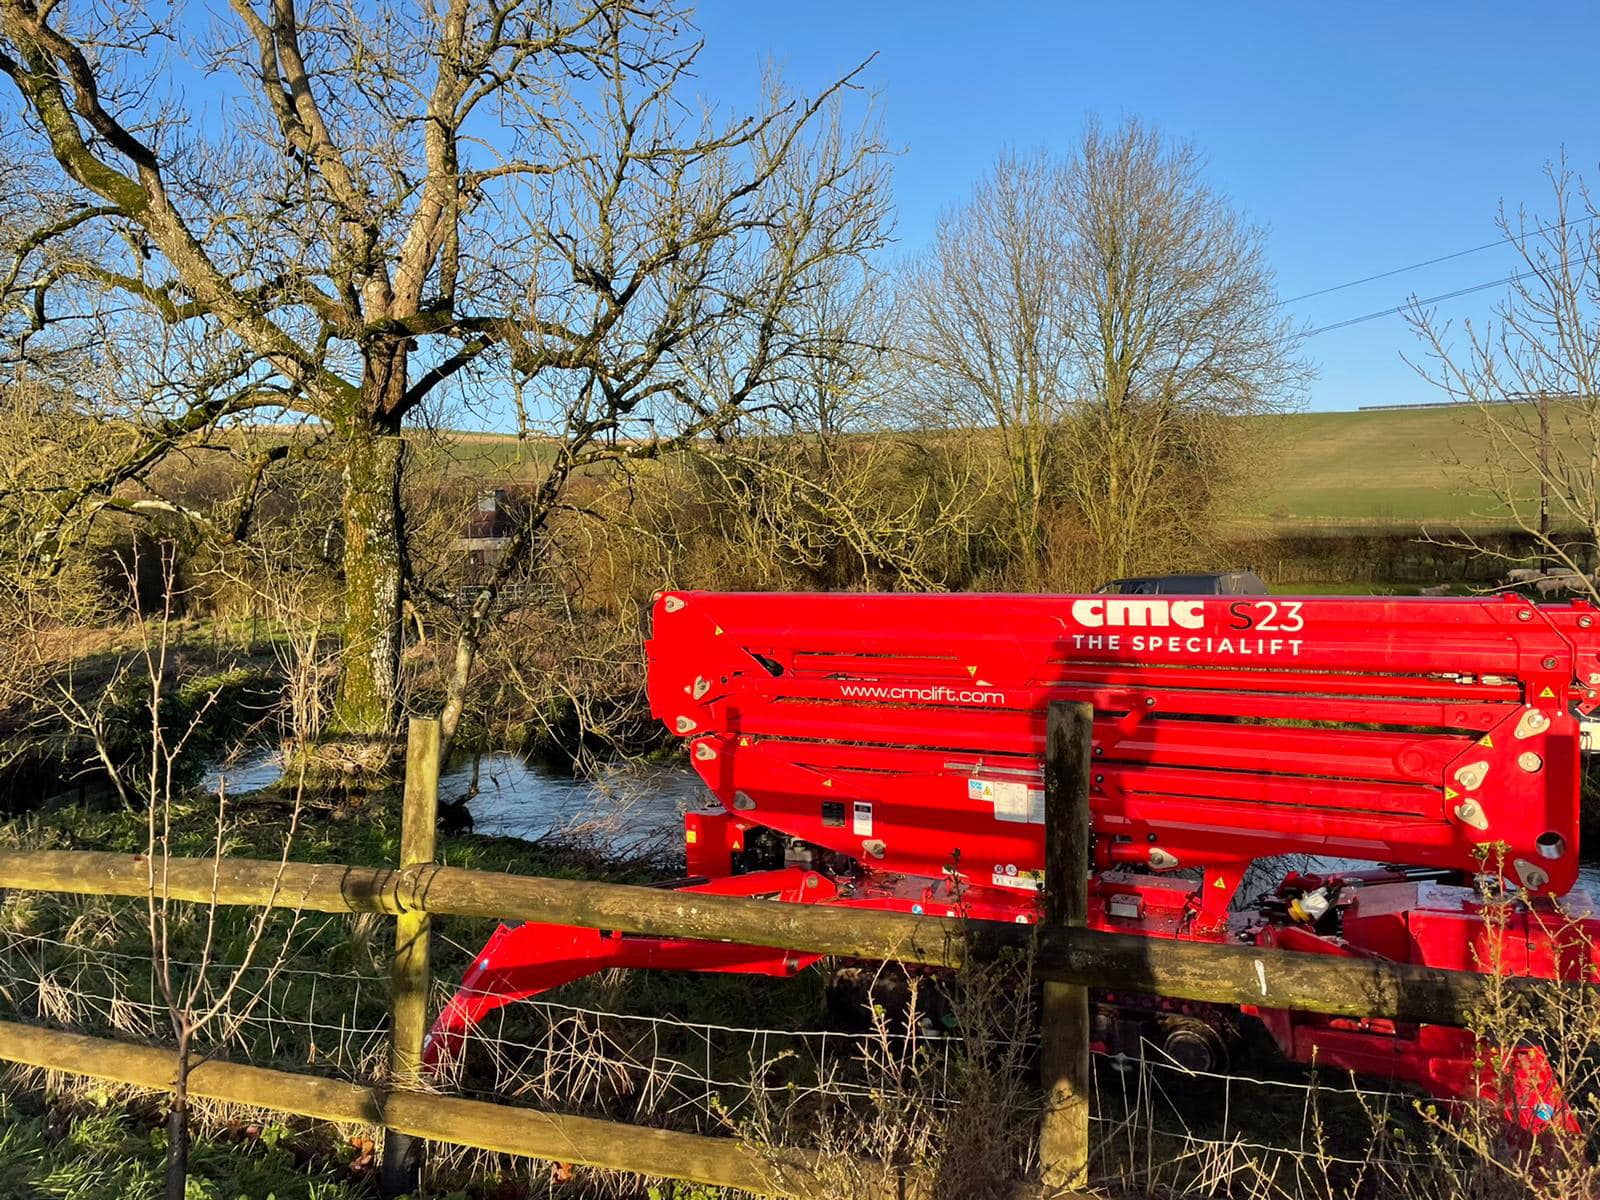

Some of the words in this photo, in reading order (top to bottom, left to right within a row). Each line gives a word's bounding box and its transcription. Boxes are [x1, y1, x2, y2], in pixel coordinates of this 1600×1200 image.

[1072, 599, 1205, 629] cmc
[1229, 601, 1304, 631] S23
[1072, 634, 1120, 650] THE
[1132, 636, 1303, 655] SPECIALIFT
[840, 686, 1005, 704] www.cmclift.com
